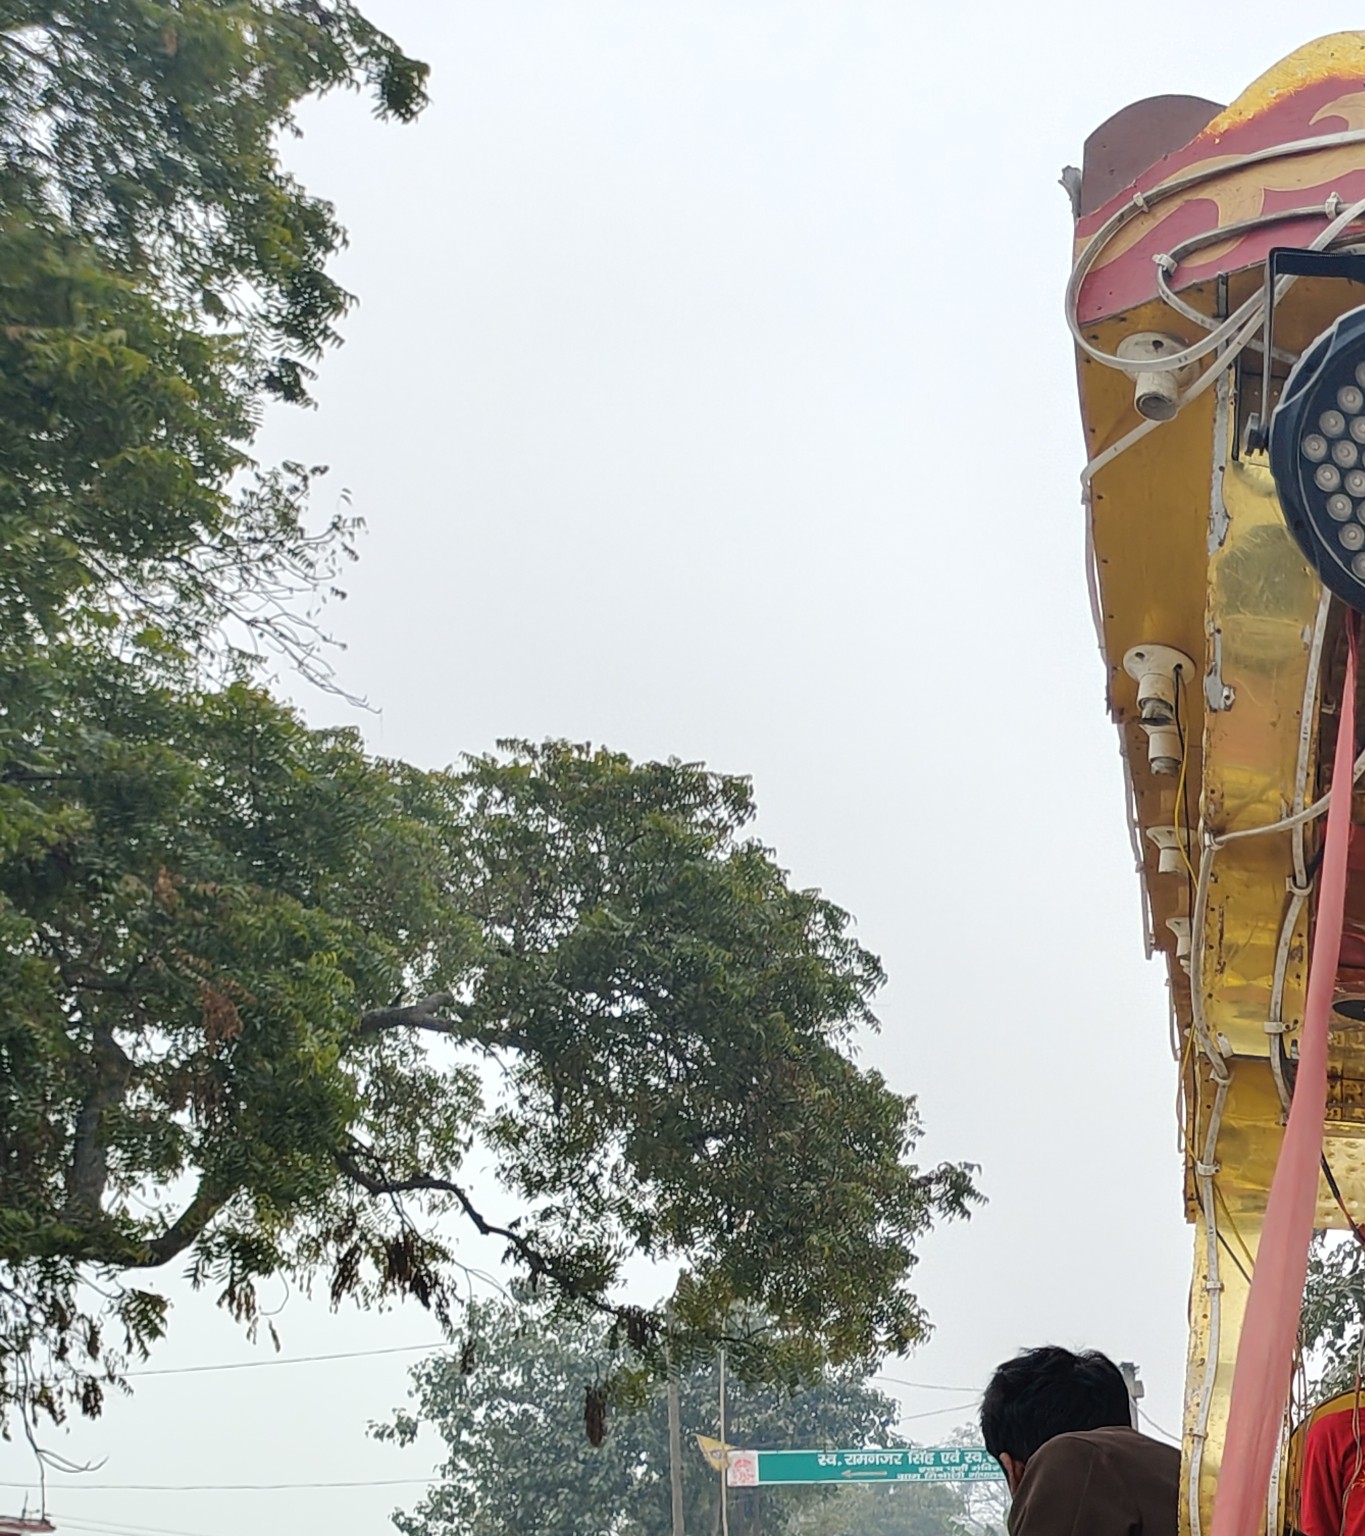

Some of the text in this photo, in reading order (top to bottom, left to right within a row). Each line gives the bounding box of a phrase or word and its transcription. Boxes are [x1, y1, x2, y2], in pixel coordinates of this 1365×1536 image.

[817, 1453, 842, 1466] स्व.
[907, 1450, 934, 1465] सिंह
[964, 1451, 986, 1464] स्व.
